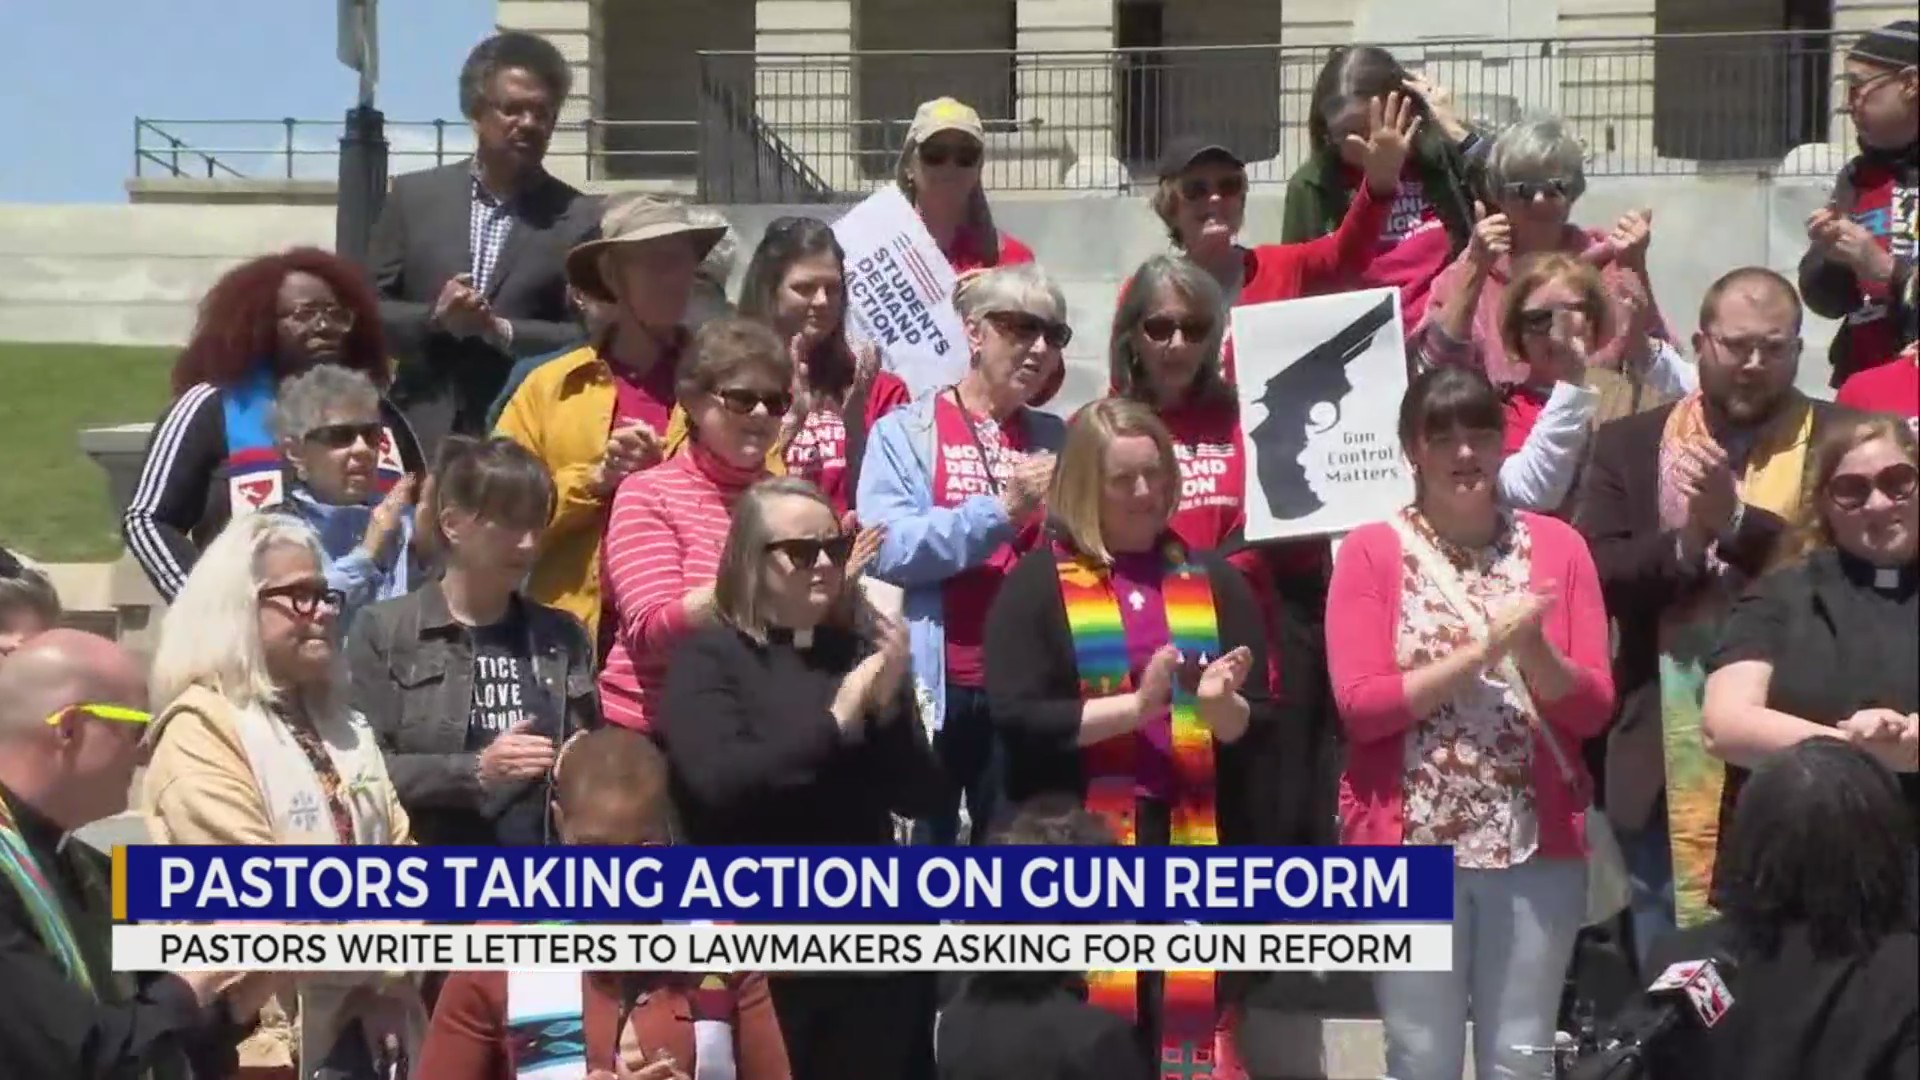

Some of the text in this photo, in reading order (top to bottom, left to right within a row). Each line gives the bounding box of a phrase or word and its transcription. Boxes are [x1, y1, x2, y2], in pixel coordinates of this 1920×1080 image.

[844, 270, 900, 346] ACTION
[857, 257, 922, 345] DEMAND
[873, 246, 951, 356] STUDENTS
[1343, 431, 1376, 445] Gun
[1327, 445, 1394, 466] Control
[1326, 466, 1399, 482] Matters
[477, 656, 519, 679] TICE
[473, 683, 522, 708] LOVE
